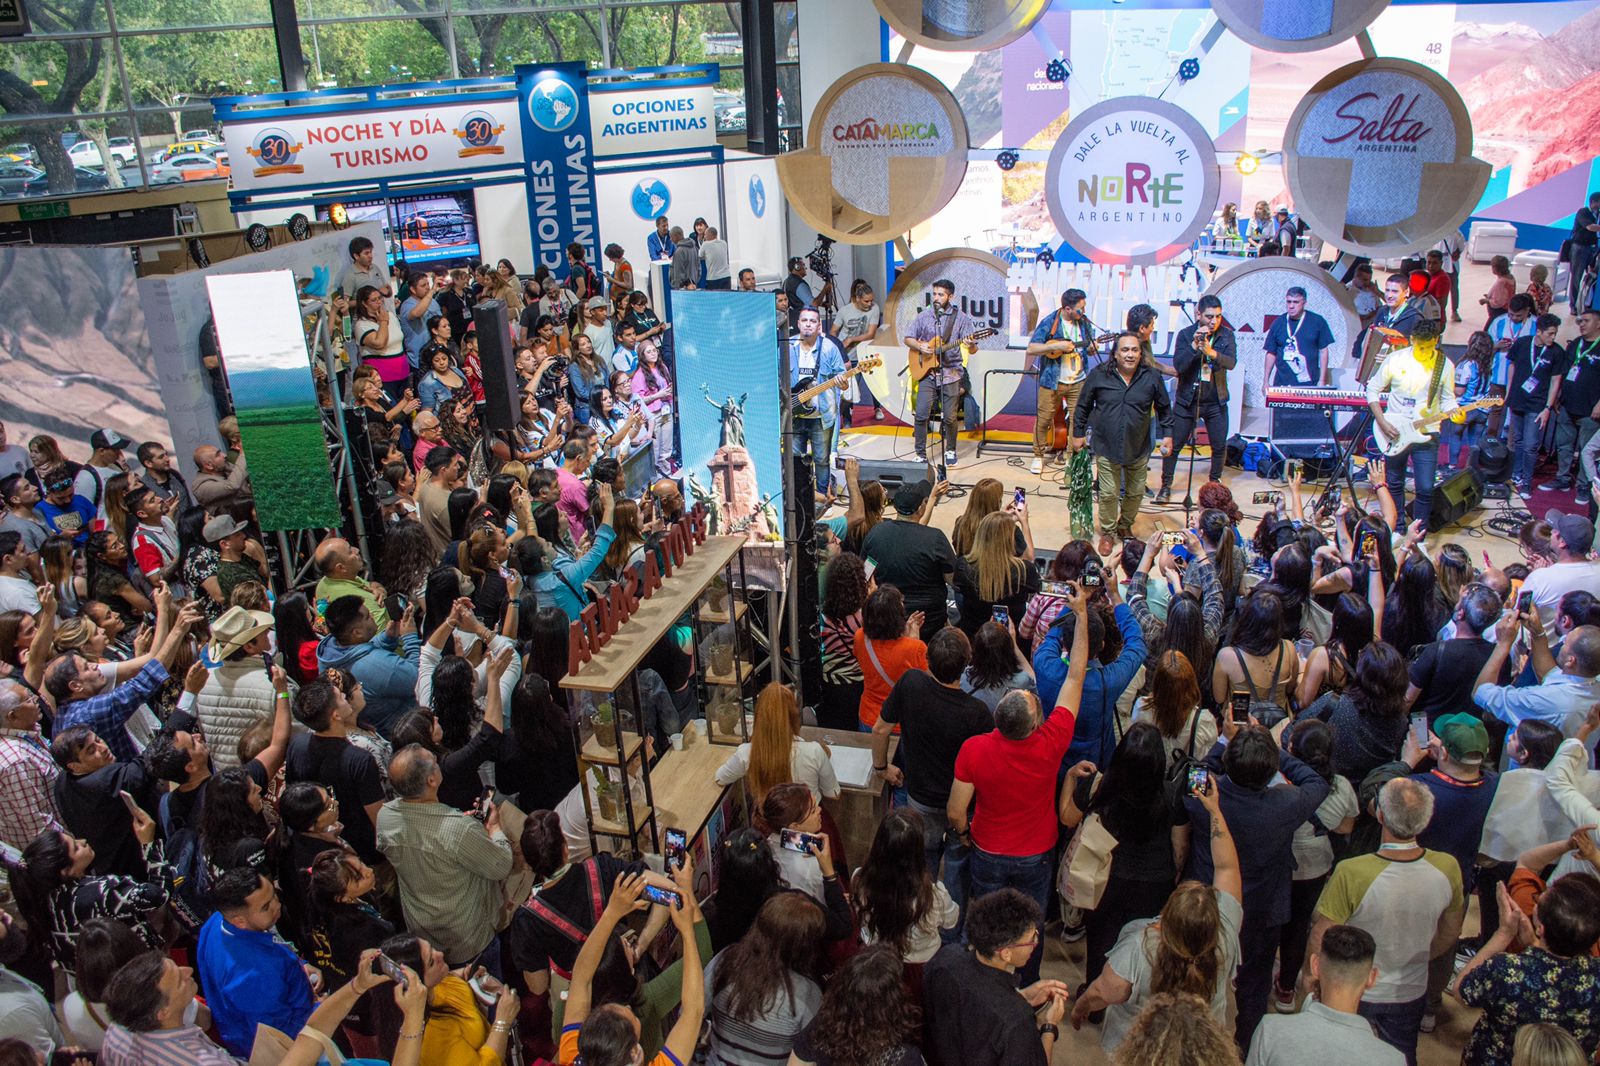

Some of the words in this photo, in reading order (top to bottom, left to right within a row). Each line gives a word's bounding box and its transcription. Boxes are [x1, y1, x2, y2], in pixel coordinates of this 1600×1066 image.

[1425, 42, 1442, 55] 48
[612, 98, 695, 116] OPCIONES
[1321, 92, 1433, 143] Salta
[306, 122, 384, 145] NOCHE
[388, 120, 403, 137] Y
[409, 113, 446, 136] DÍA
[467, 120, 489, 141] 30
[602, 117, 707, 137] ARGENTINAS
[832, 117, 940, 141] CATAMARCA
[263, 138, 287, 160] 30
[1074, 133, 1101, 162] DALE
[1105, 122, 1122, 137] LA
[1130, 120, 1176, 147] VUELTA
[1175, 149, 1190, 165] AL
[1355, 143, 1418, 153] ARGENTINA
[330, 144, 429, 168] TURISMO
[532, 159, 563, 285] CIONES
[1078, 211, 1183, 222] ARGENTINO
